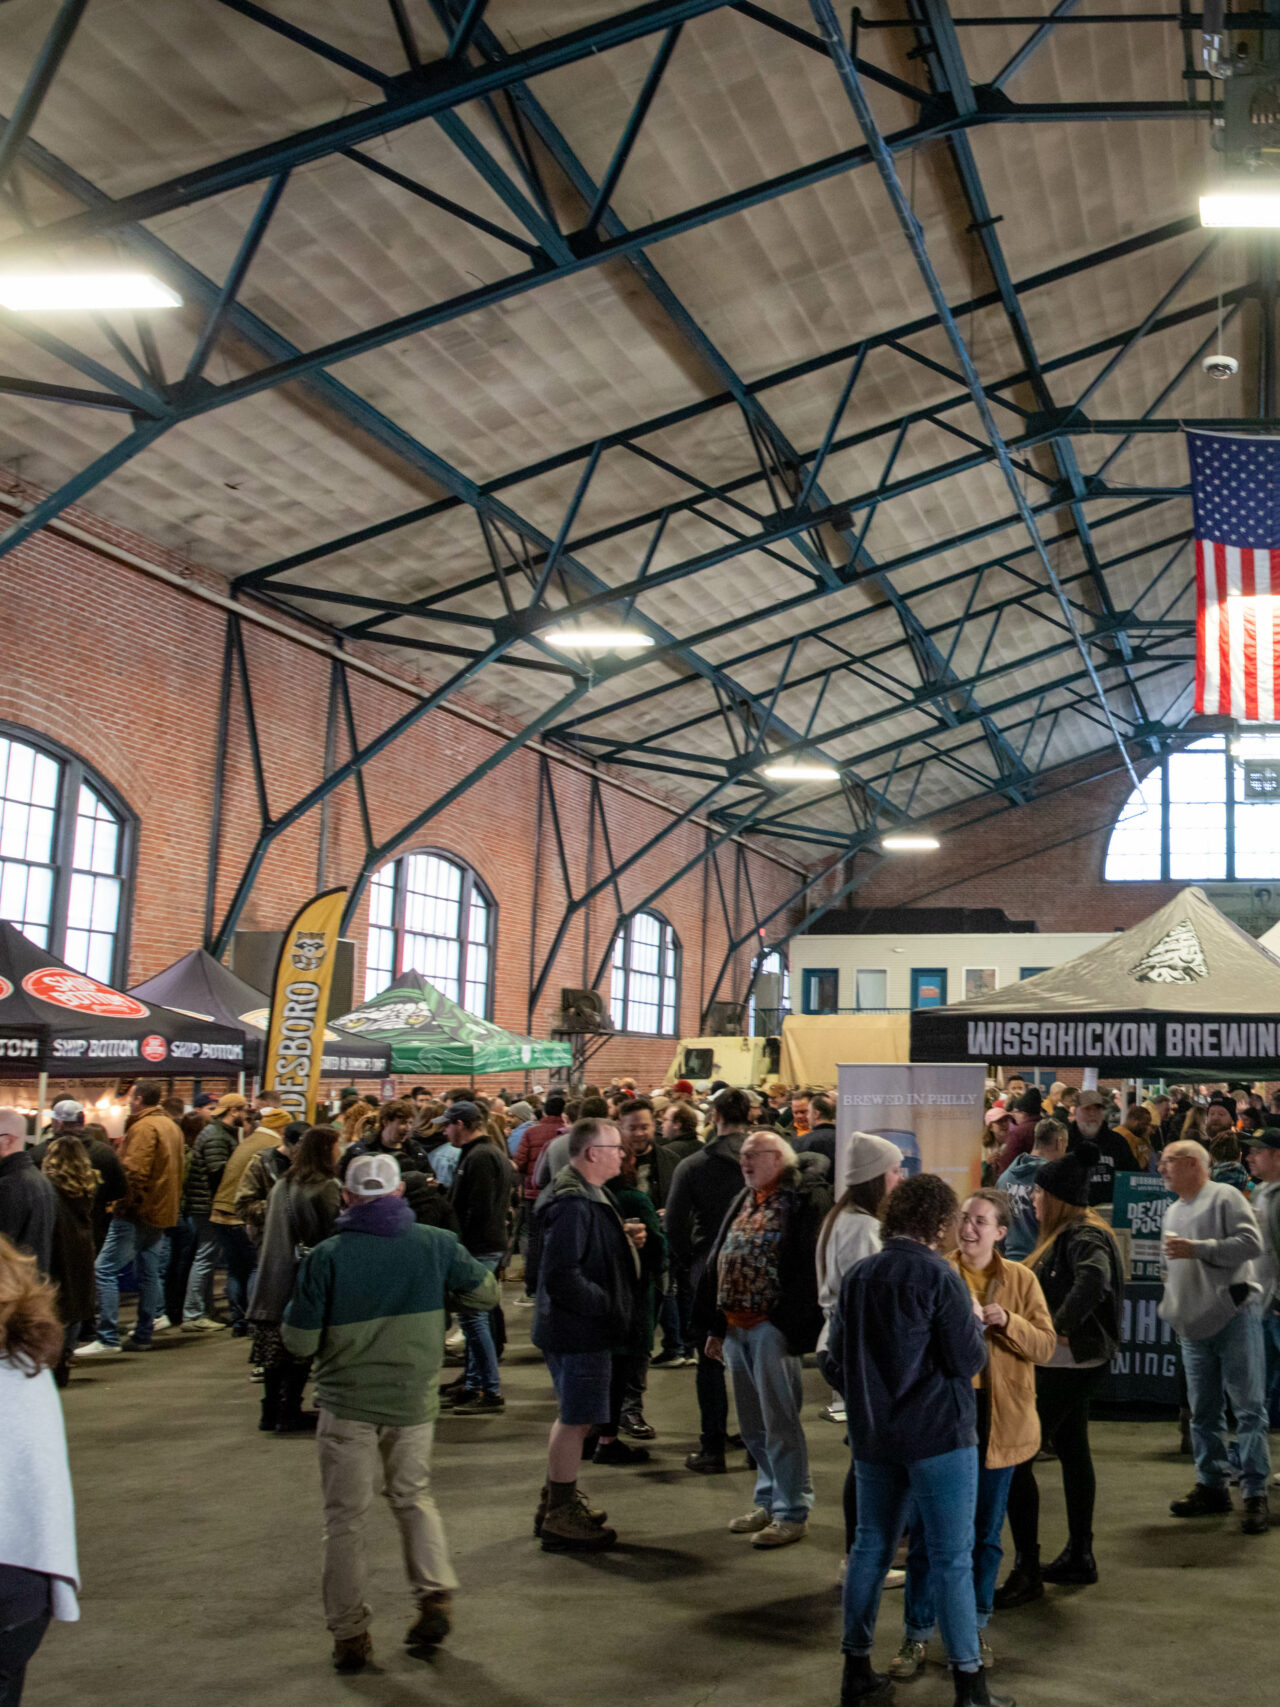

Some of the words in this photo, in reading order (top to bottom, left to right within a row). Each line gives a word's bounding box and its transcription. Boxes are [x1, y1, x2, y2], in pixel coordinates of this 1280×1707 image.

[53, 1038, 88, 1057] SHIP
[88, 1040, 139, 1057] BOTTOM
[968, 1021, 1157, 1057] WISSAHICKON
[170, 1041, 201, 1058] SHIP
[201, 1043, 244, 1060] BOTTOM
[274, 982, 320, 1121] DESBORO
[843, 1094, 905, 1106] BREWED
[906, 1094, 925, 1105] IN
[927, 1094, 977, 1105] PHILLY
